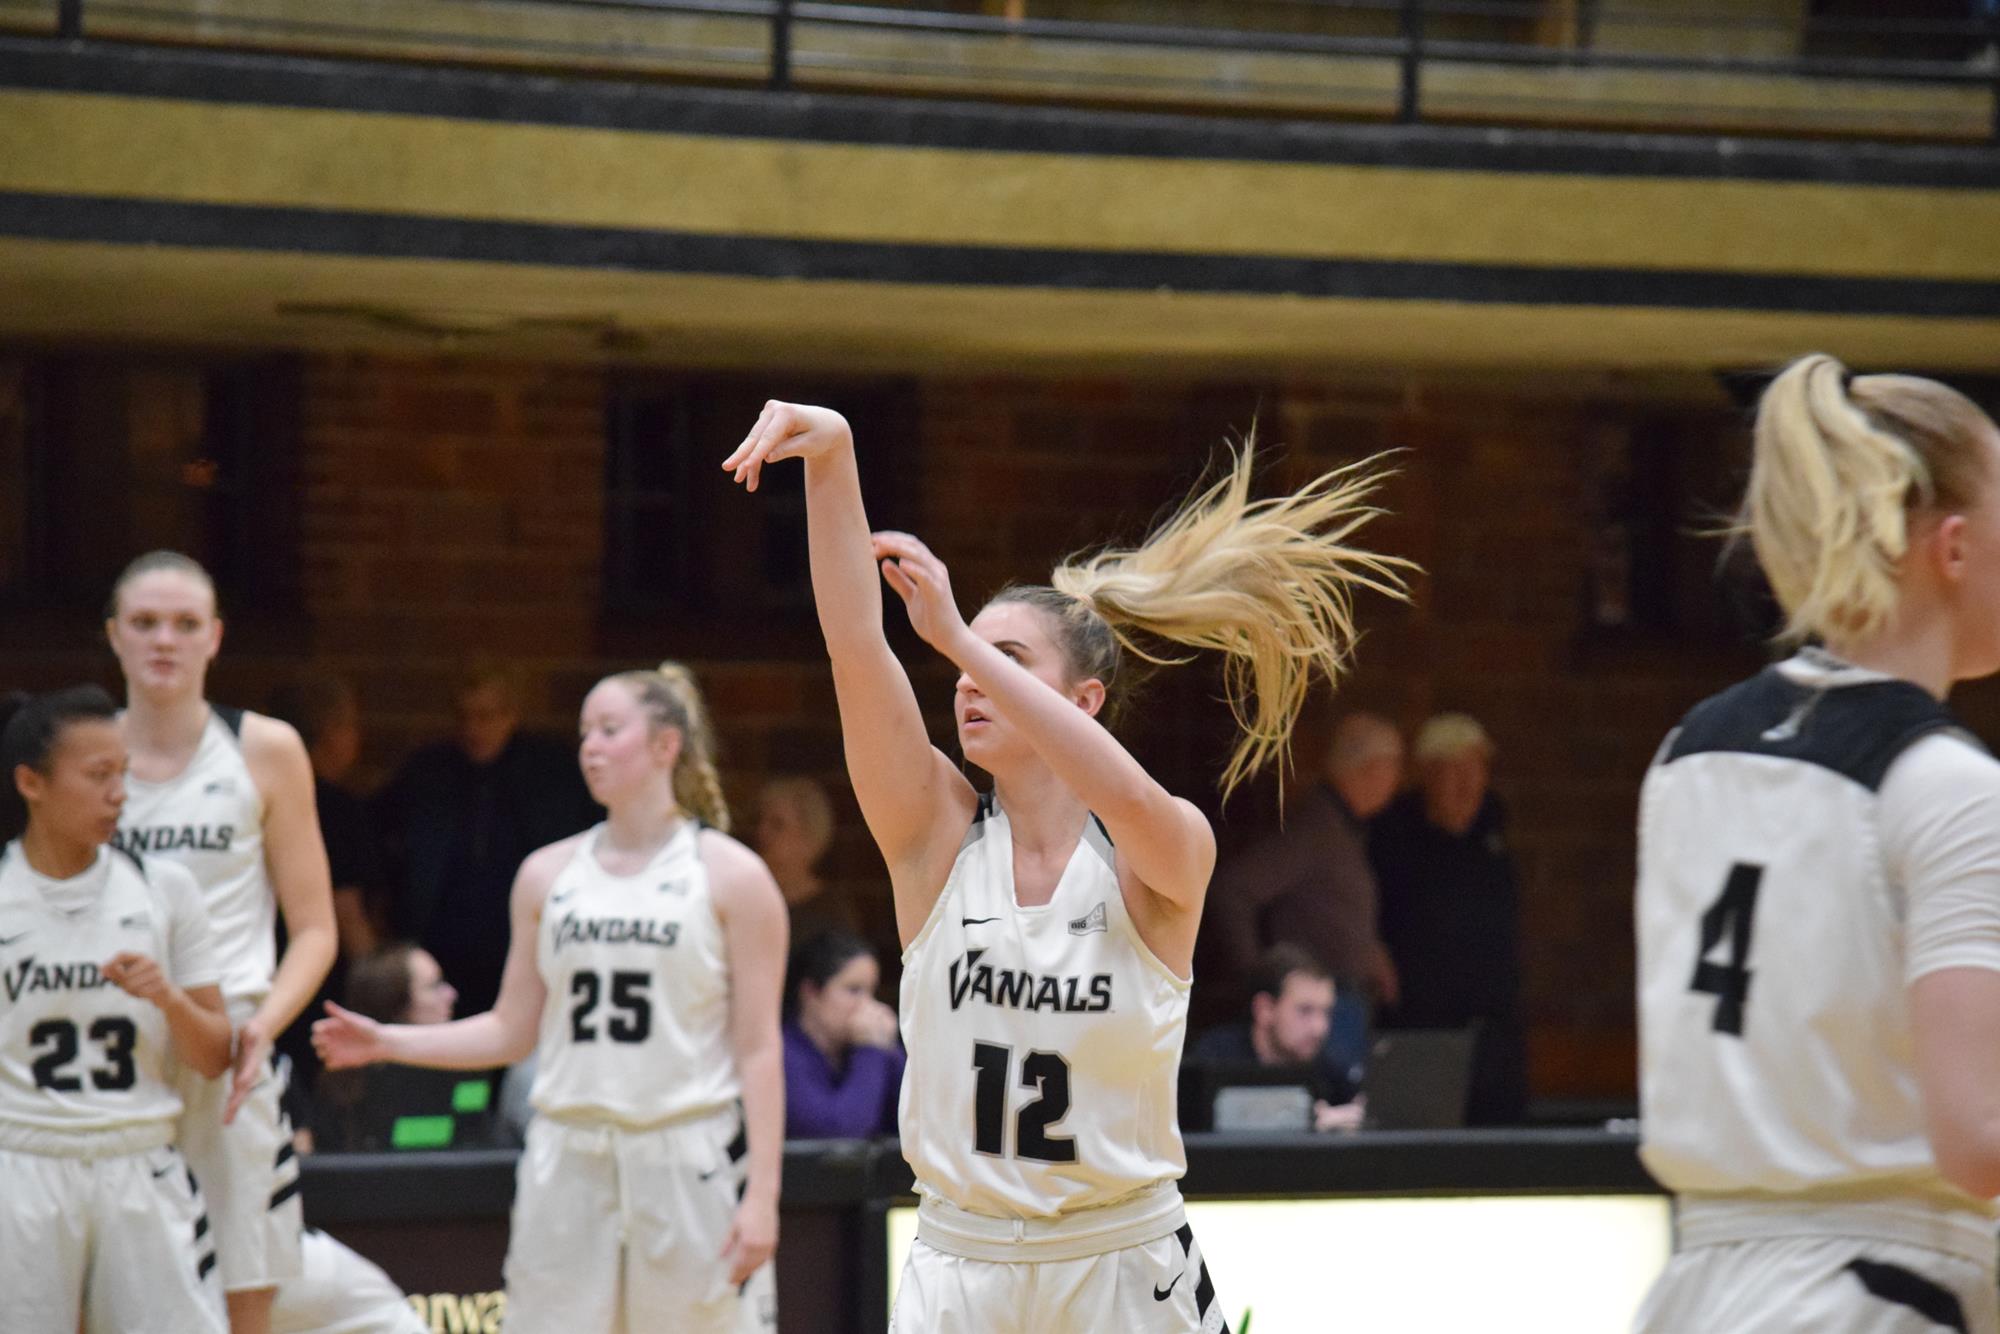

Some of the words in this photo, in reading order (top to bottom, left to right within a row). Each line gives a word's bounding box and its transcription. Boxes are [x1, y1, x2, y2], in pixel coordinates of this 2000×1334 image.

[109, 824, 235, 851] ANDALS
[551, 910, 681, 954] VANDALS
[1689, 861, 1766, 1037] 4
[3, 953, 113, 1004] VAND
[570, 969, 652, 1044] 25
[29, 1015, 137, 1092] 23
[971, 1038, 1080, 1166] 12
